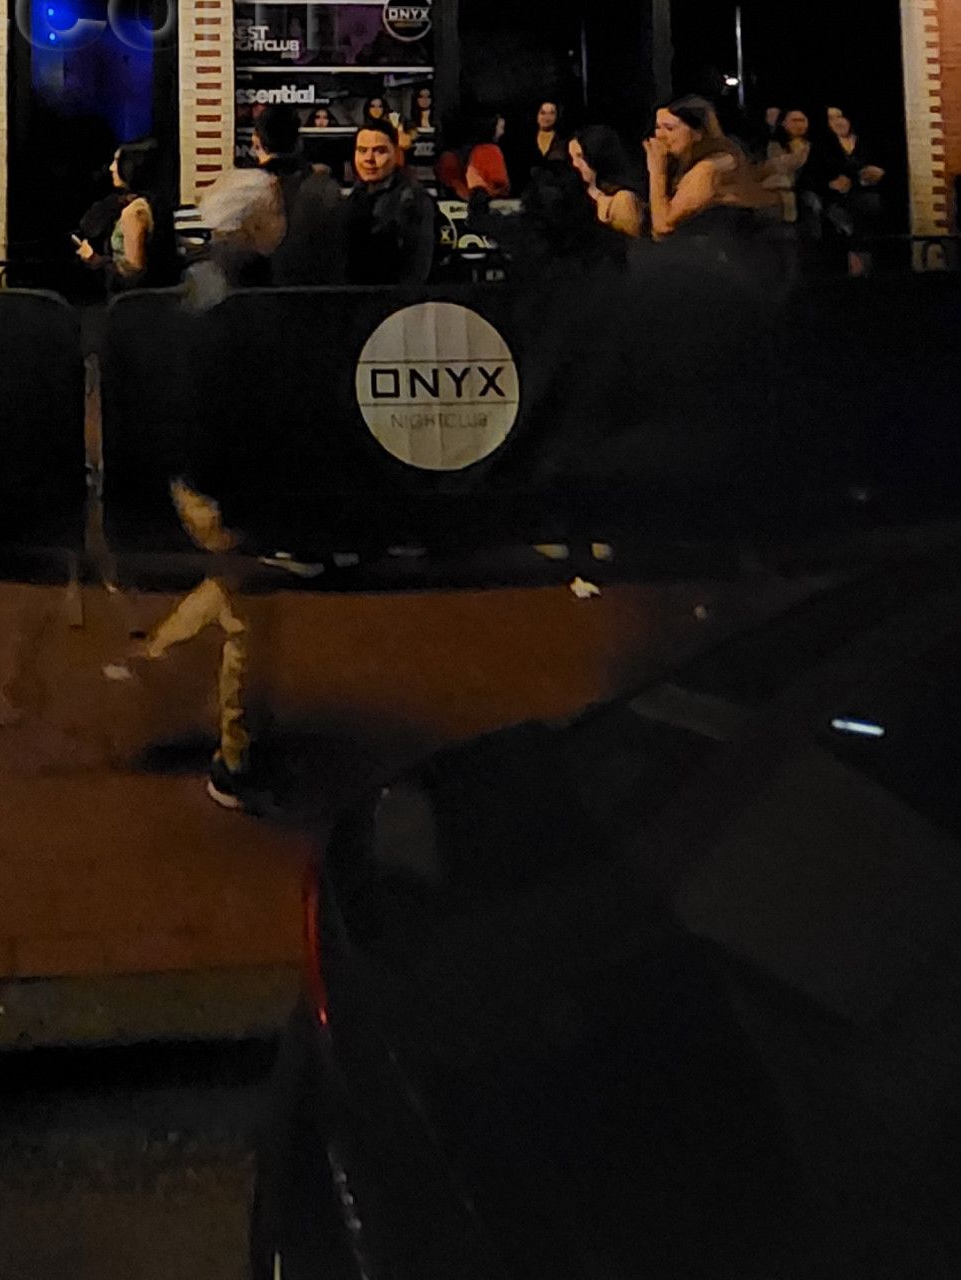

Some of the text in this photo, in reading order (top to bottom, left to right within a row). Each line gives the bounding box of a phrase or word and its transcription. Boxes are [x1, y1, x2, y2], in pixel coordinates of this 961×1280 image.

[388, 6, 430, 20] ONYX
[235, 26, 269, 40] EST
[371, 366, 505, 398] ONYX
